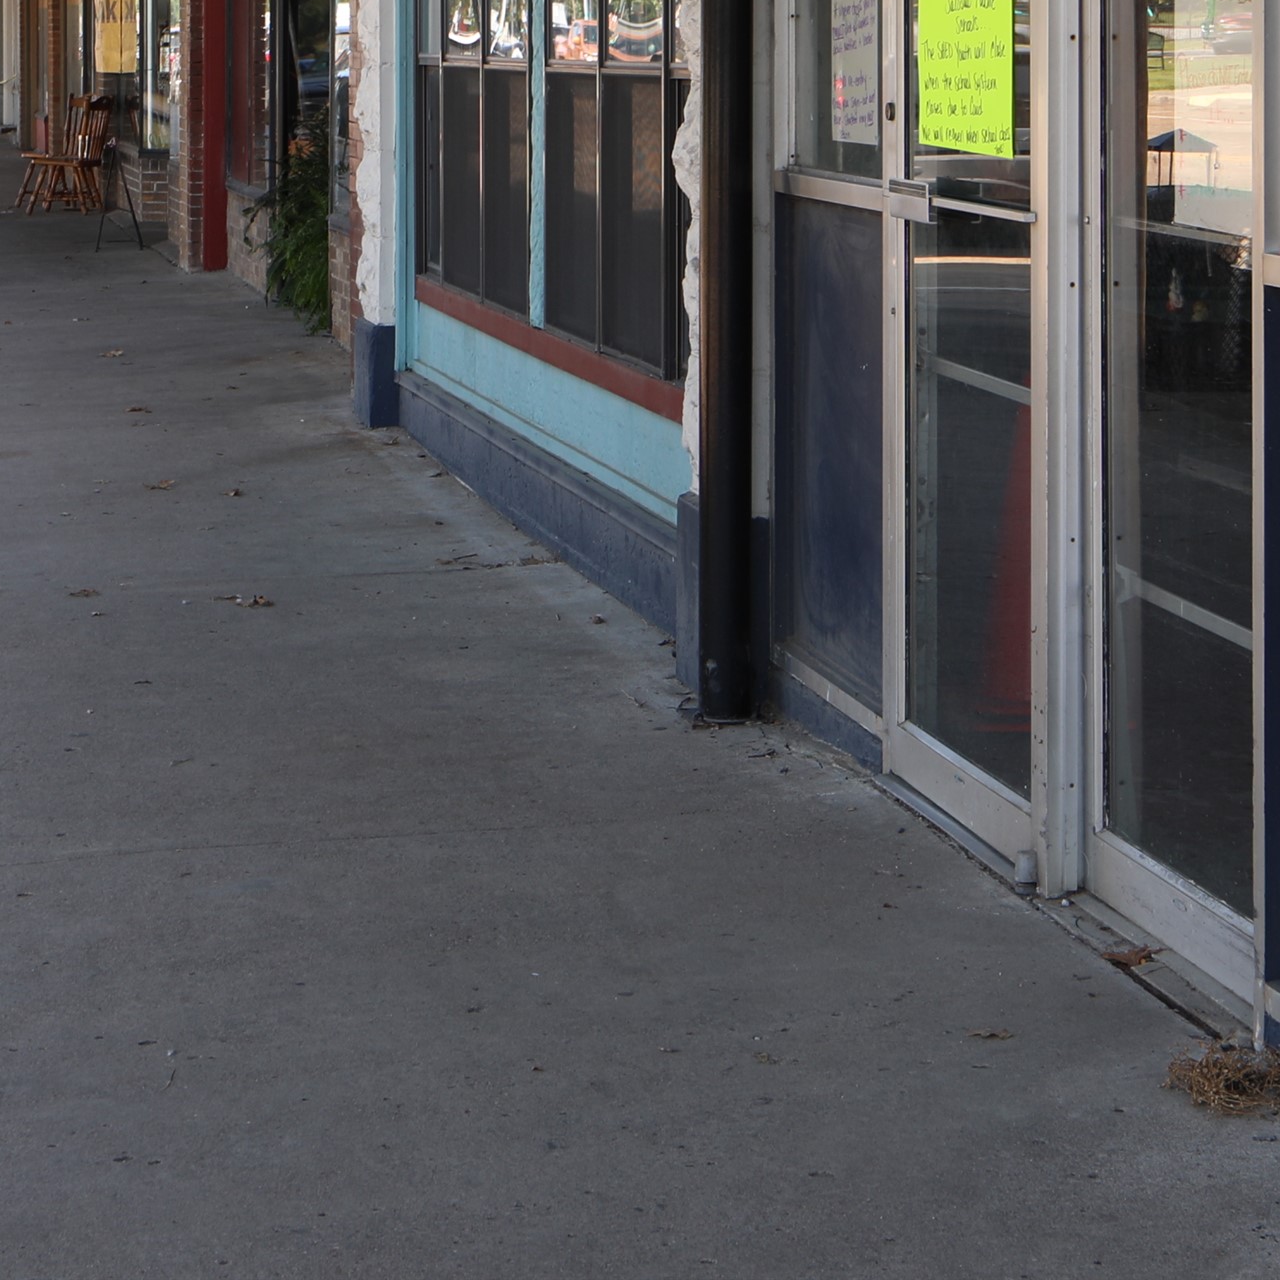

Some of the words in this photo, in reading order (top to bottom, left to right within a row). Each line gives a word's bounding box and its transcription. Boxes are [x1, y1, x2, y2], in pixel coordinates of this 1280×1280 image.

[921, 39, 935, 61] The
[954, 41, 972, 68] Youth
[974, 41, 986, 59] will
[942, 72, 952, 90] the
[947, 97, 959, 117] due
[961, 99, 967, 116] to
[921, 124, 931, 142] We
[933, 126, 943, 142] will
